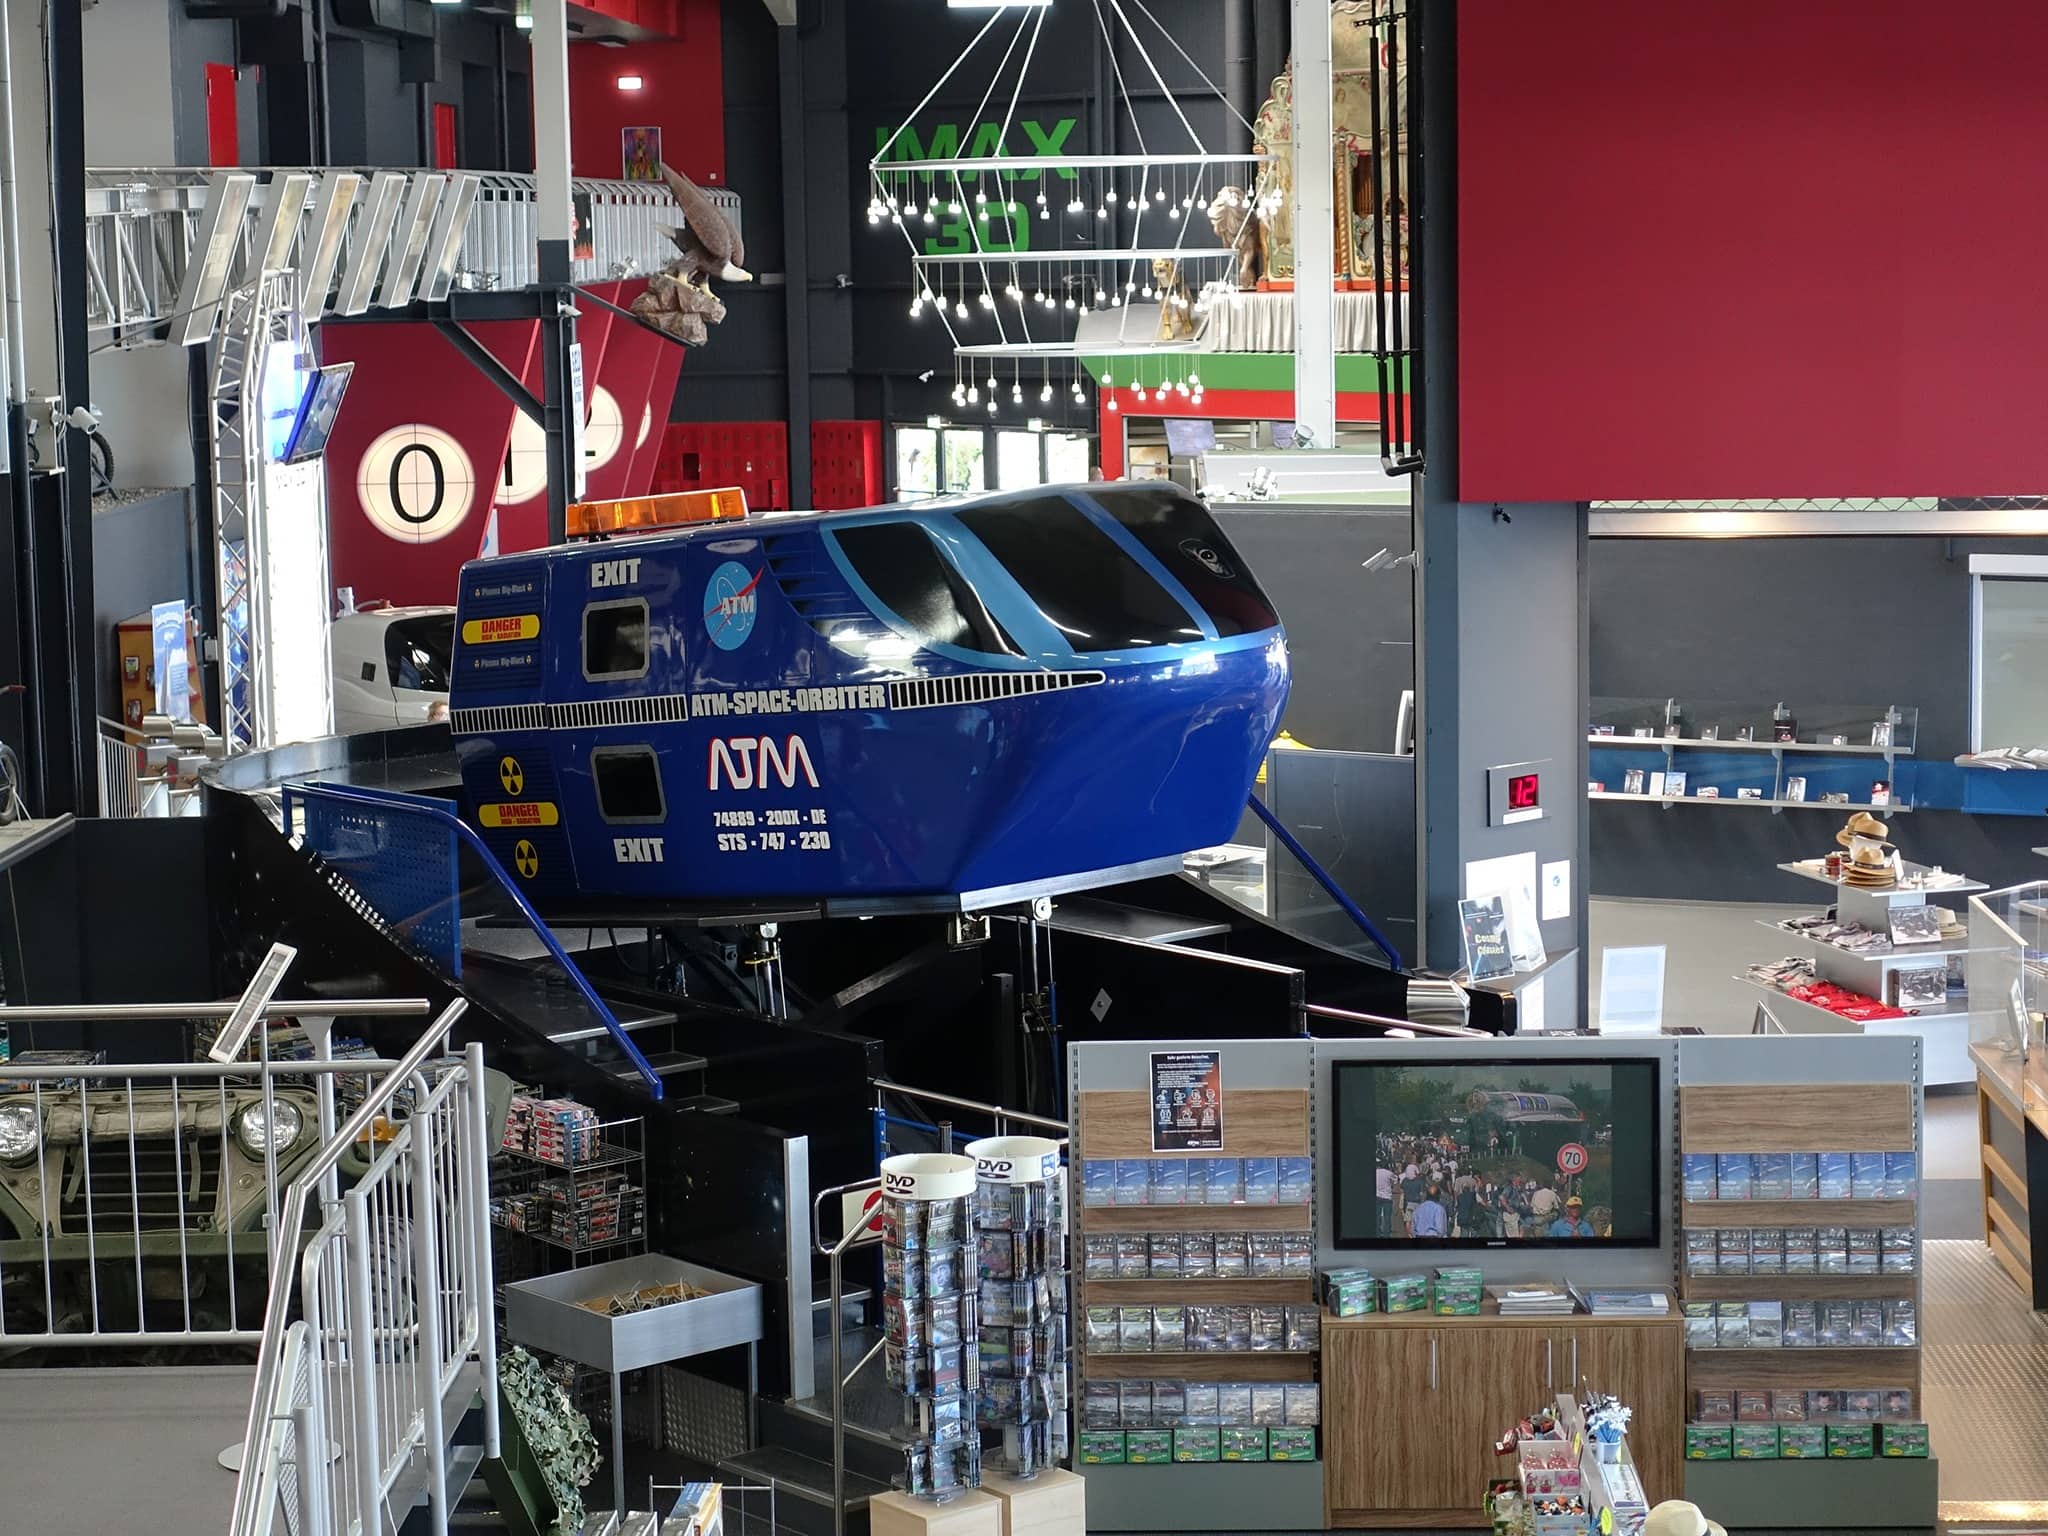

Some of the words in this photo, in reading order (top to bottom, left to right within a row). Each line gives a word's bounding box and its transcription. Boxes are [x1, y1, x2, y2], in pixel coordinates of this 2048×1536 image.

[875, 118, 1078, 184] IMAX
[924, 201, 1030, 256] 3D
[591, 557, 642, 588] EXIT
[720, 594, 754, 615] ATM
[481, 617, 522, 634] DANGER
[691, 684, 887, 718] ATM-SPACE-ORBITER
[1516, 776, 1537, 805] 12
[498, 804, 540, 818] DANGER
[713, 811, 756, 827] 74889
[765, 809, 800, 826] 200X
[810, 808, 828, 825] DE
[613, 837, 665, 862] EXIT
[717, 833, 748, 851] STS
[759, 832, 785, 850] 747
[799, 831, 831, 850] 230
[978, 1159, 1013, 1172] DVD
[1565, 1151, 1581, 1166] 70
[886, 1173, 916, 1187] DVD
